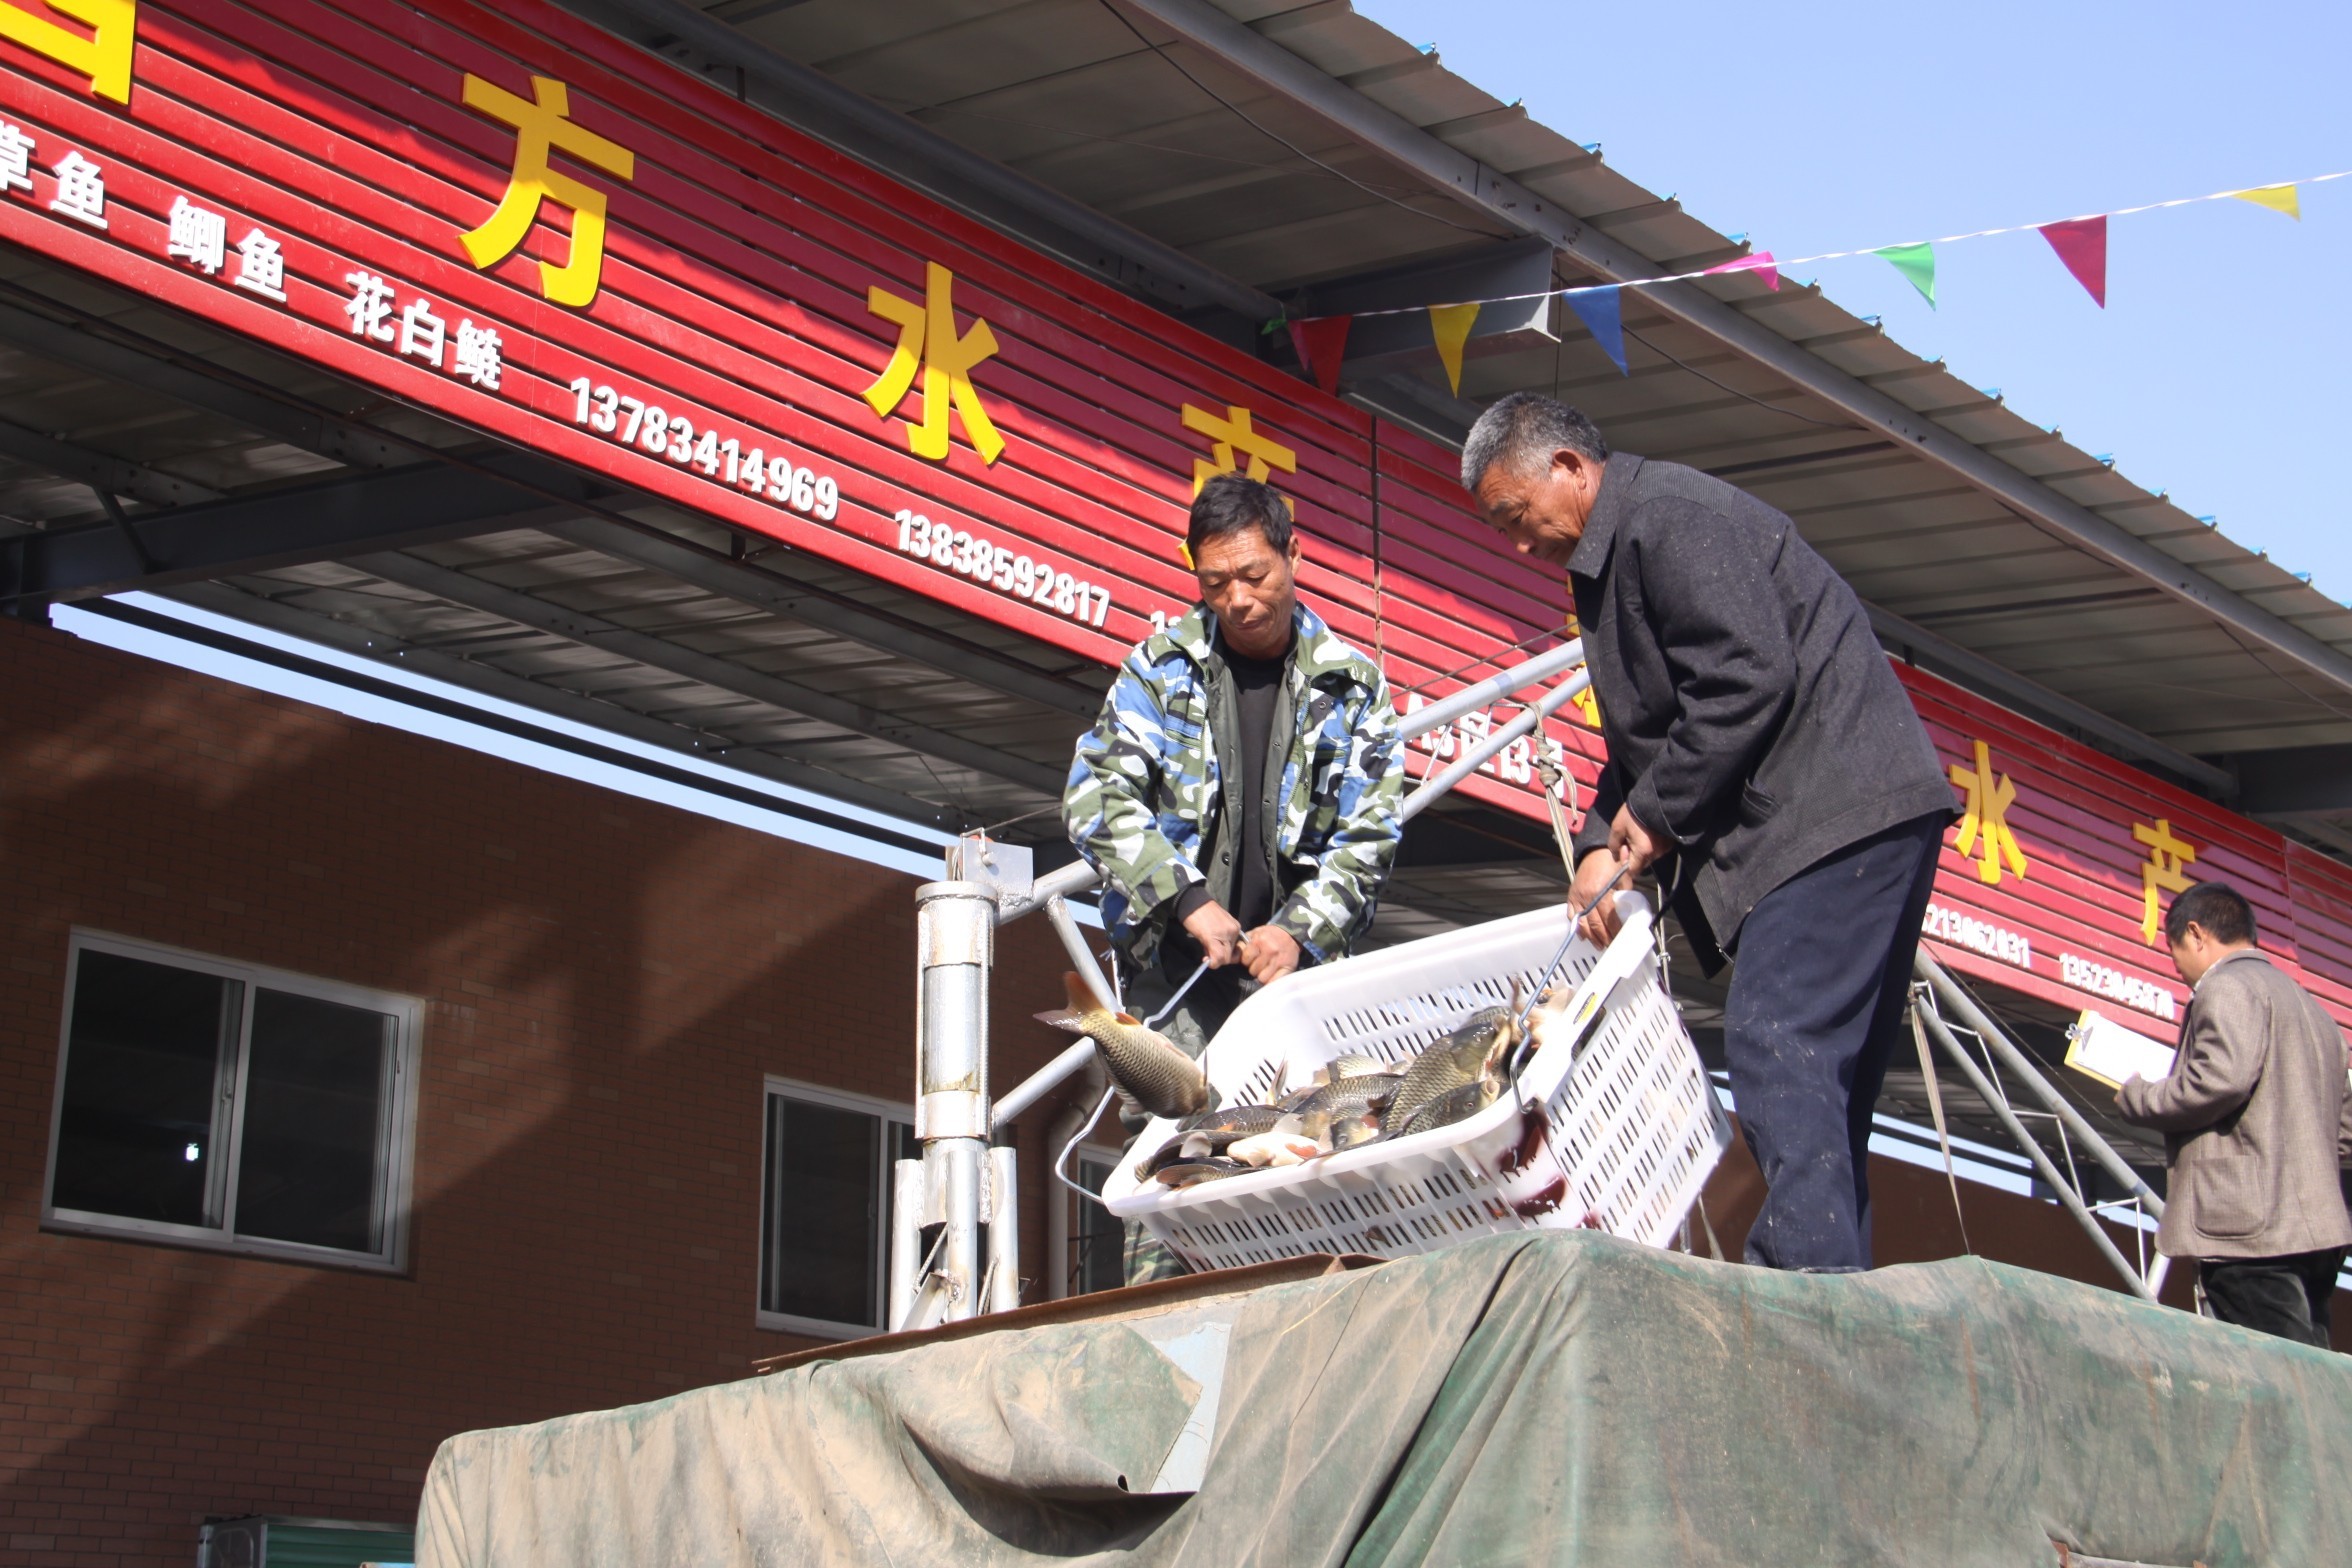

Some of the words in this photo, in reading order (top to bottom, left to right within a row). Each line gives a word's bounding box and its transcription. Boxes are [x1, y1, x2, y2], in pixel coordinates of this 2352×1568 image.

[168, 195, 287, 302] 鲫鱼
[344, 271, 503, 391] 花白鲢
[570, 377, 839, 521] 13783414969
[895, 509, 1110, 627] 13838592817
